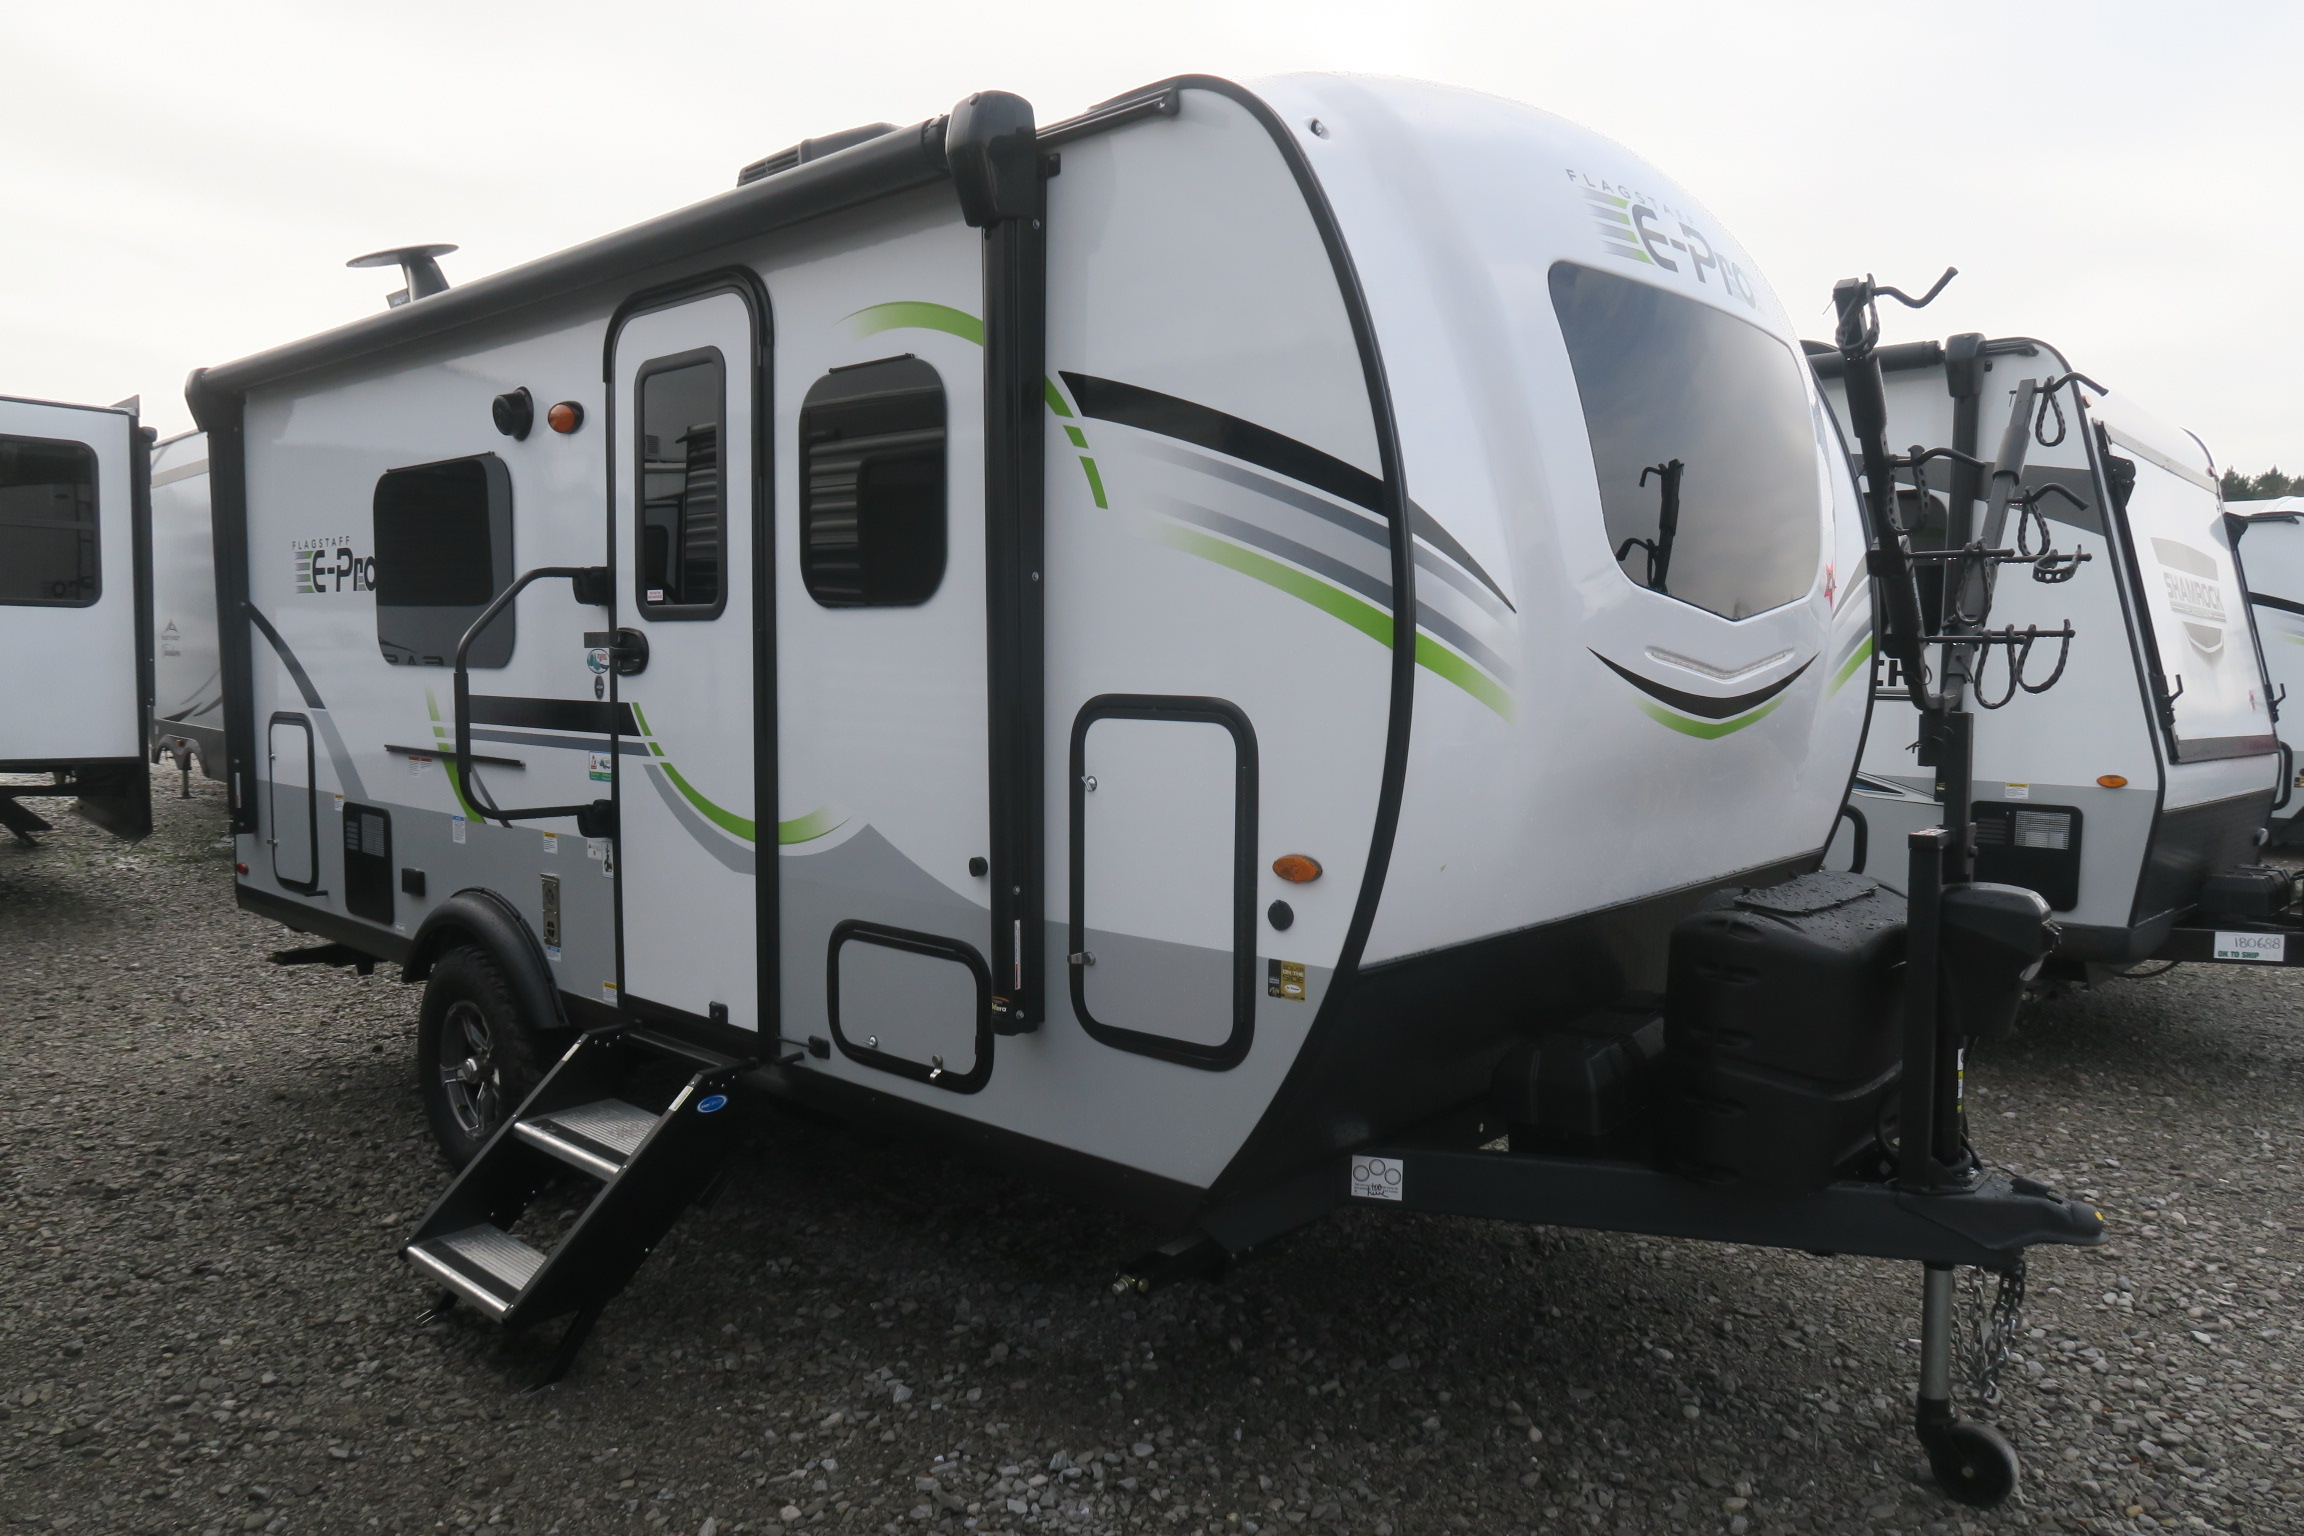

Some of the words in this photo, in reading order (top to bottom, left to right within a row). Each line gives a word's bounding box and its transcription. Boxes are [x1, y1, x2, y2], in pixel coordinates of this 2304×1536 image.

[1565, 168, 1694, 224] FLAGSTAFF
[292, 535, 350, 550] FLAGSTAFF
[2163, 571, 2226, 613] SHAMROCK
[2217, 950, 2229, 958] OK
[2230, 950, 2240, 958] TO
[2241, 951, 2260, 959] SHIP
